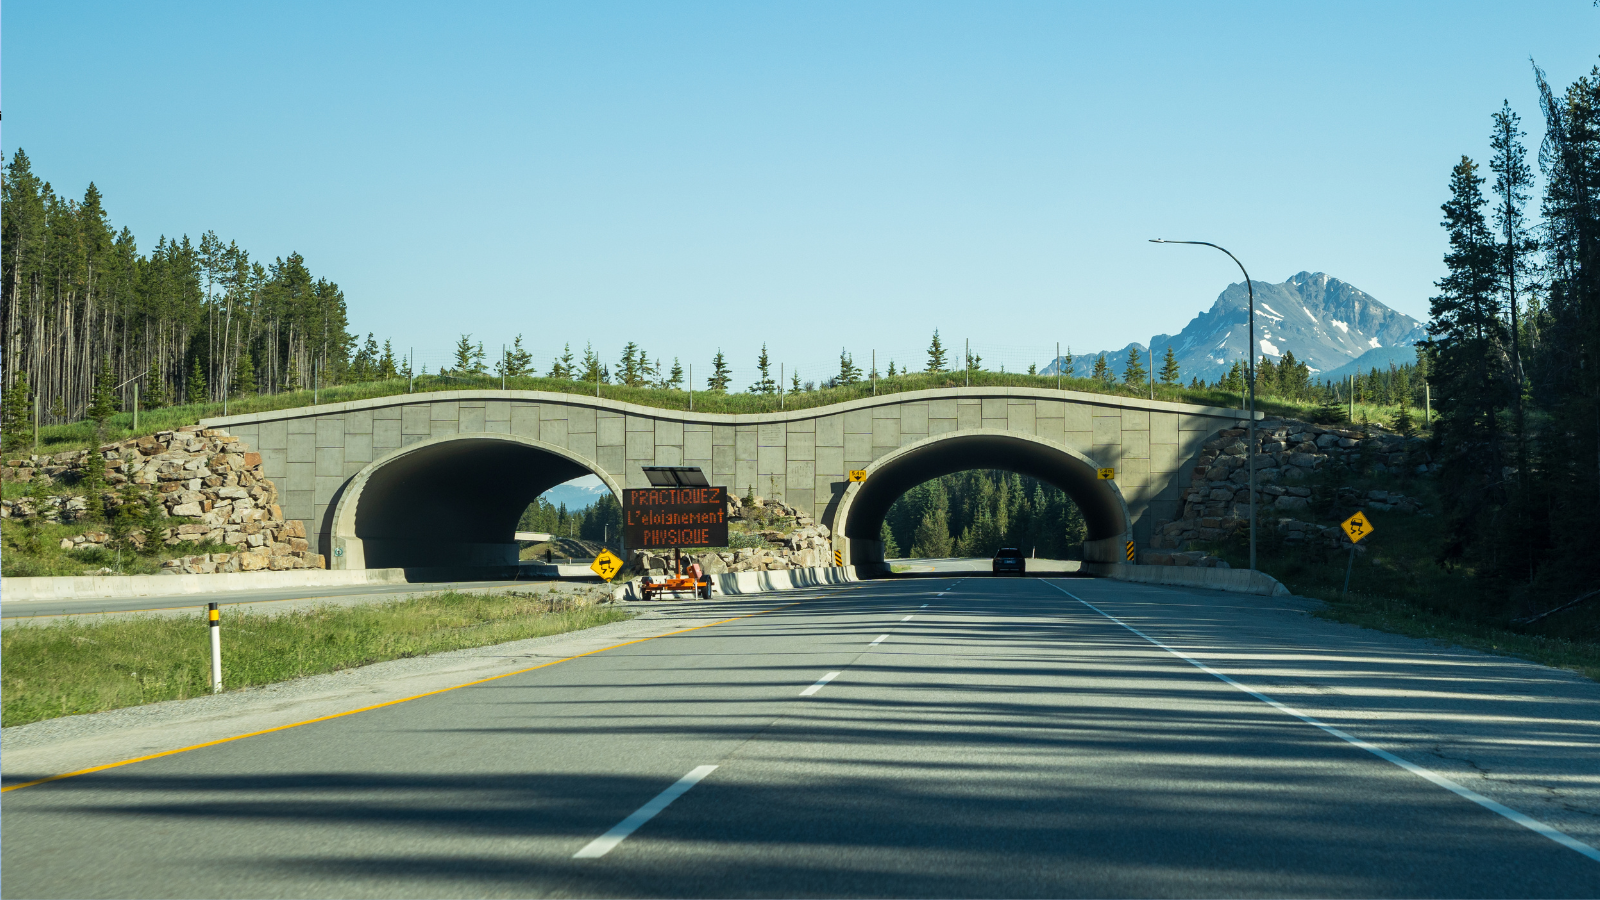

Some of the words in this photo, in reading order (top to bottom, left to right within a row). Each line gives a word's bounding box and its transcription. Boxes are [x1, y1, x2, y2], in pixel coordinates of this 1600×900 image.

[631, 488, 720, 505] PRACTIQUEZ
[627, 508, 724, 525] L'eloignement
[643, 528, 709, 545] PHYSIQUE
